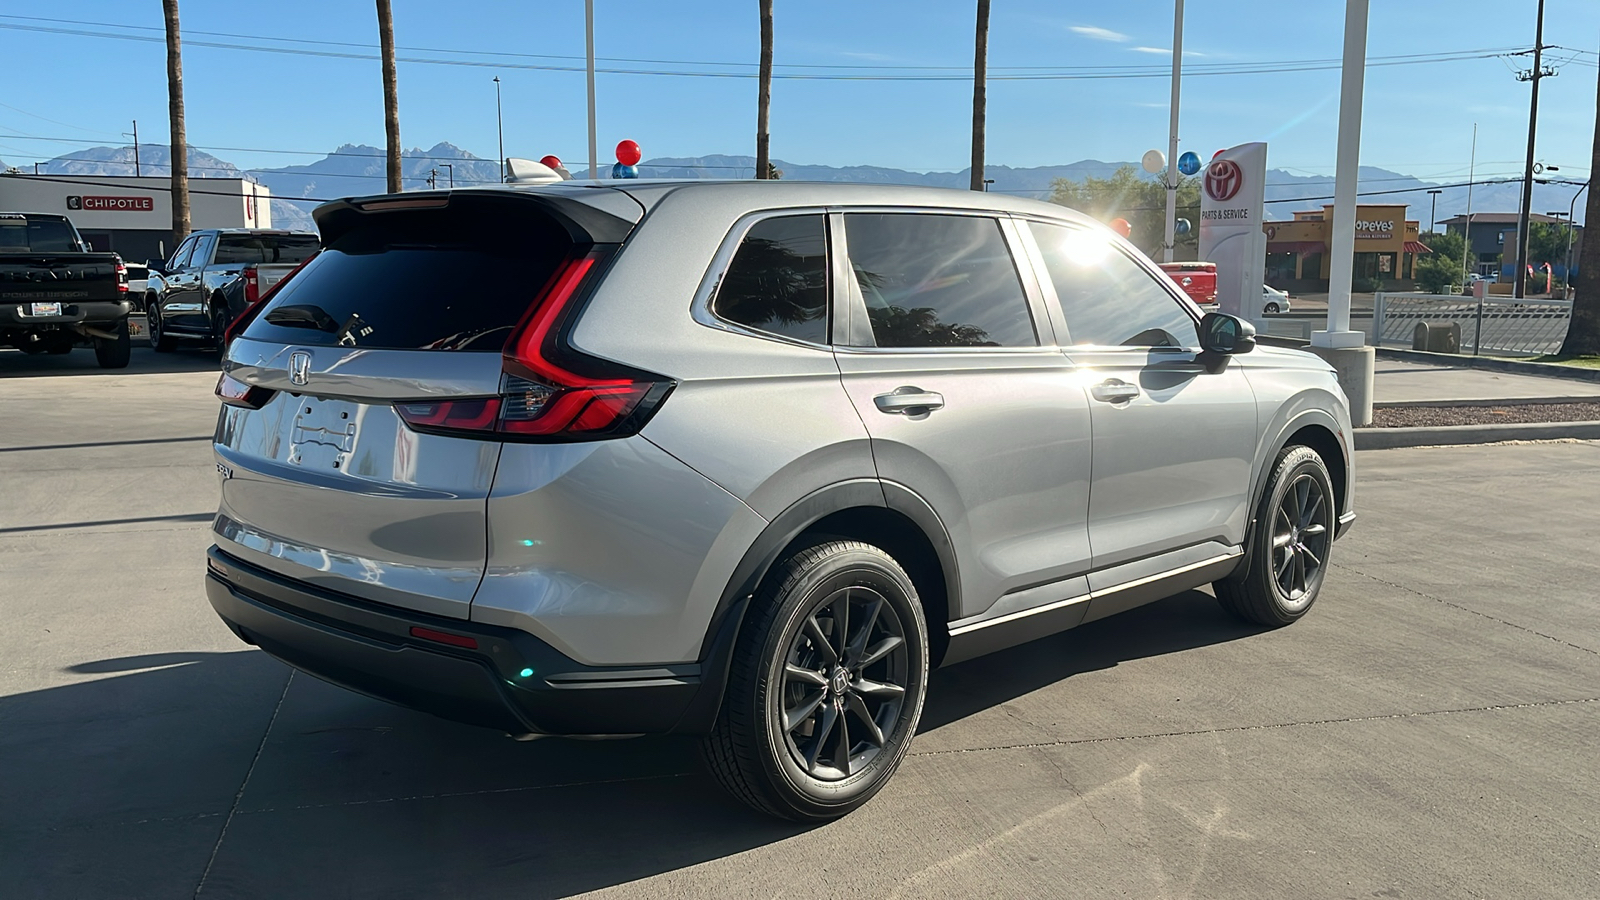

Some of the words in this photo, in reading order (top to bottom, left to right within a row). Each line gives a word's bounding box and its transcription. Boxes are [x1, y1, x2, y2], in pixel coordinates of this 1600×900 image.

[85, 198, 150, 209] CHIPOTLE
[1202, 210, 1218, 220] PARTS
[1223, 209, 1248, 219] SERVICE
